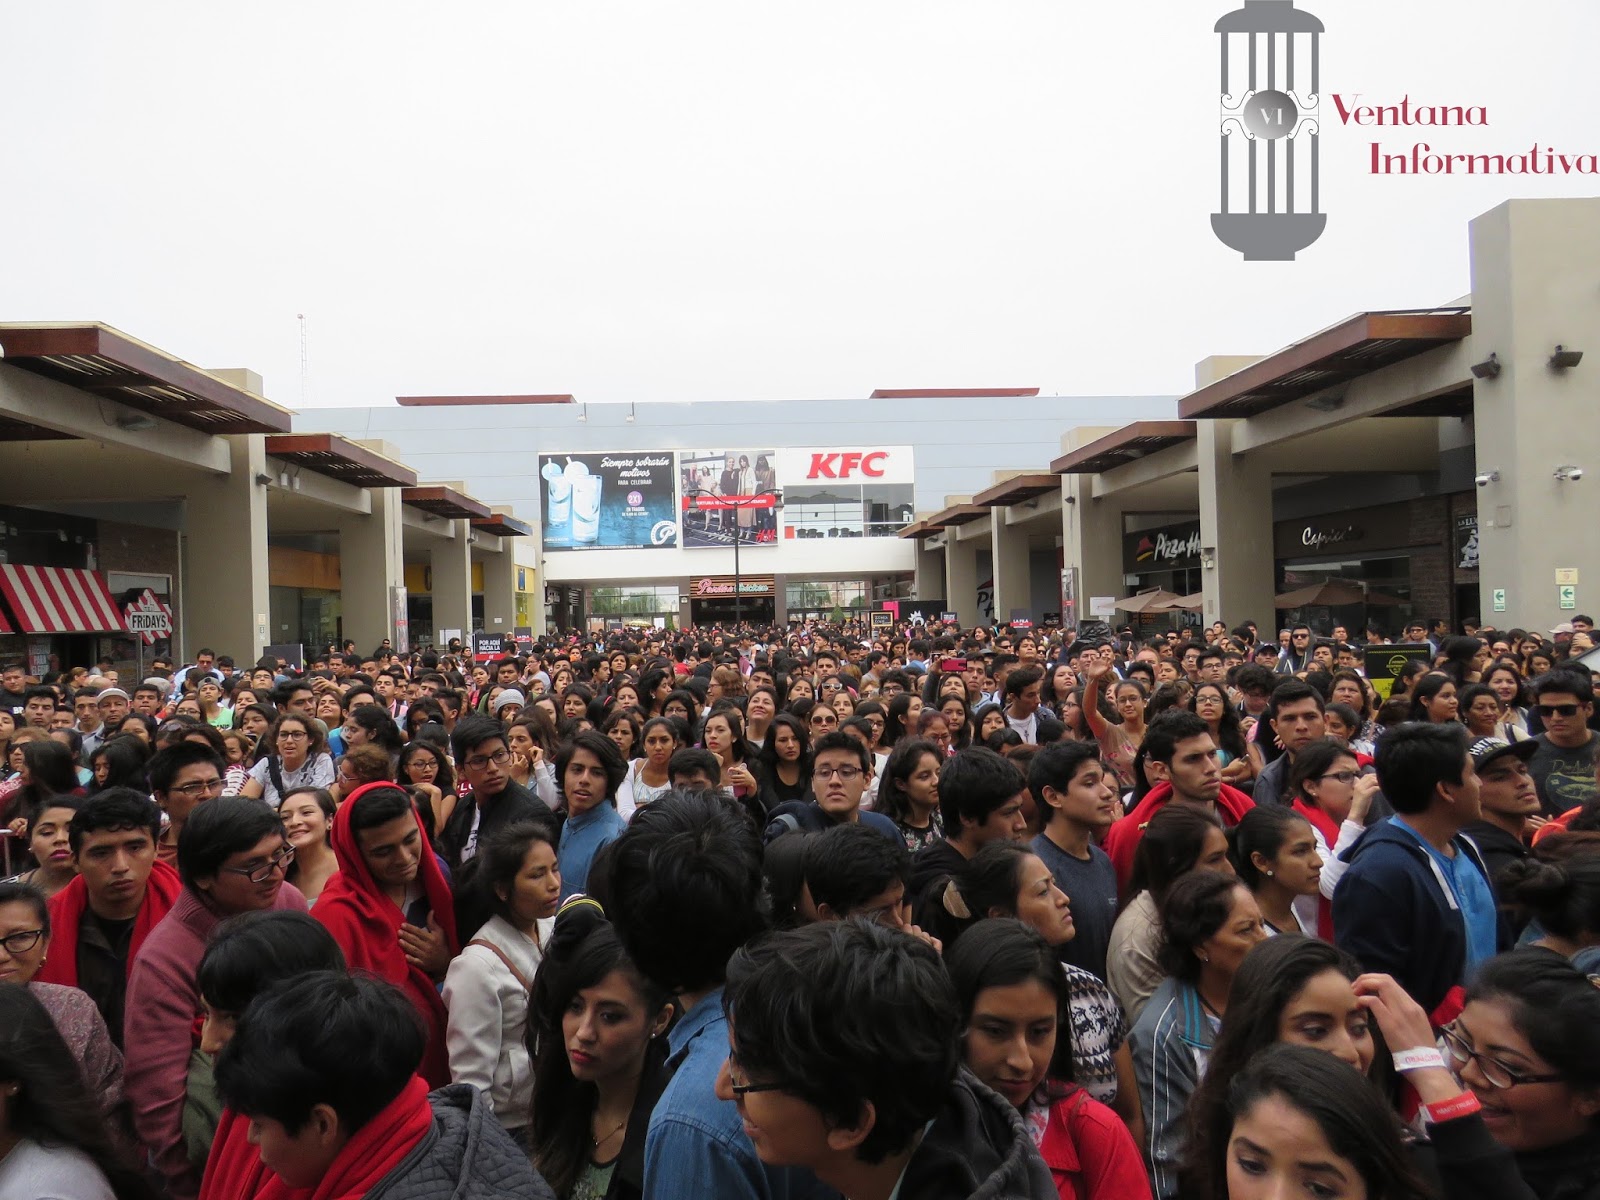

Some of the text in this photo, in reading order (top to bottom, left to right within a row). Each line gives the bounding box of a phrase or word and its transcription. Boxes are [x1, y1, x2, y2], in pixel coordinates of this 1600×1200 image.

[600, 456, 670, 469] Siempre sobrarán
[806, 451, 886, 479] KFC
[620, 467, 650, 478] motivos
[628, 495, 641, 503] 2X1
[1154, 533, 1187, 561] Pizza
